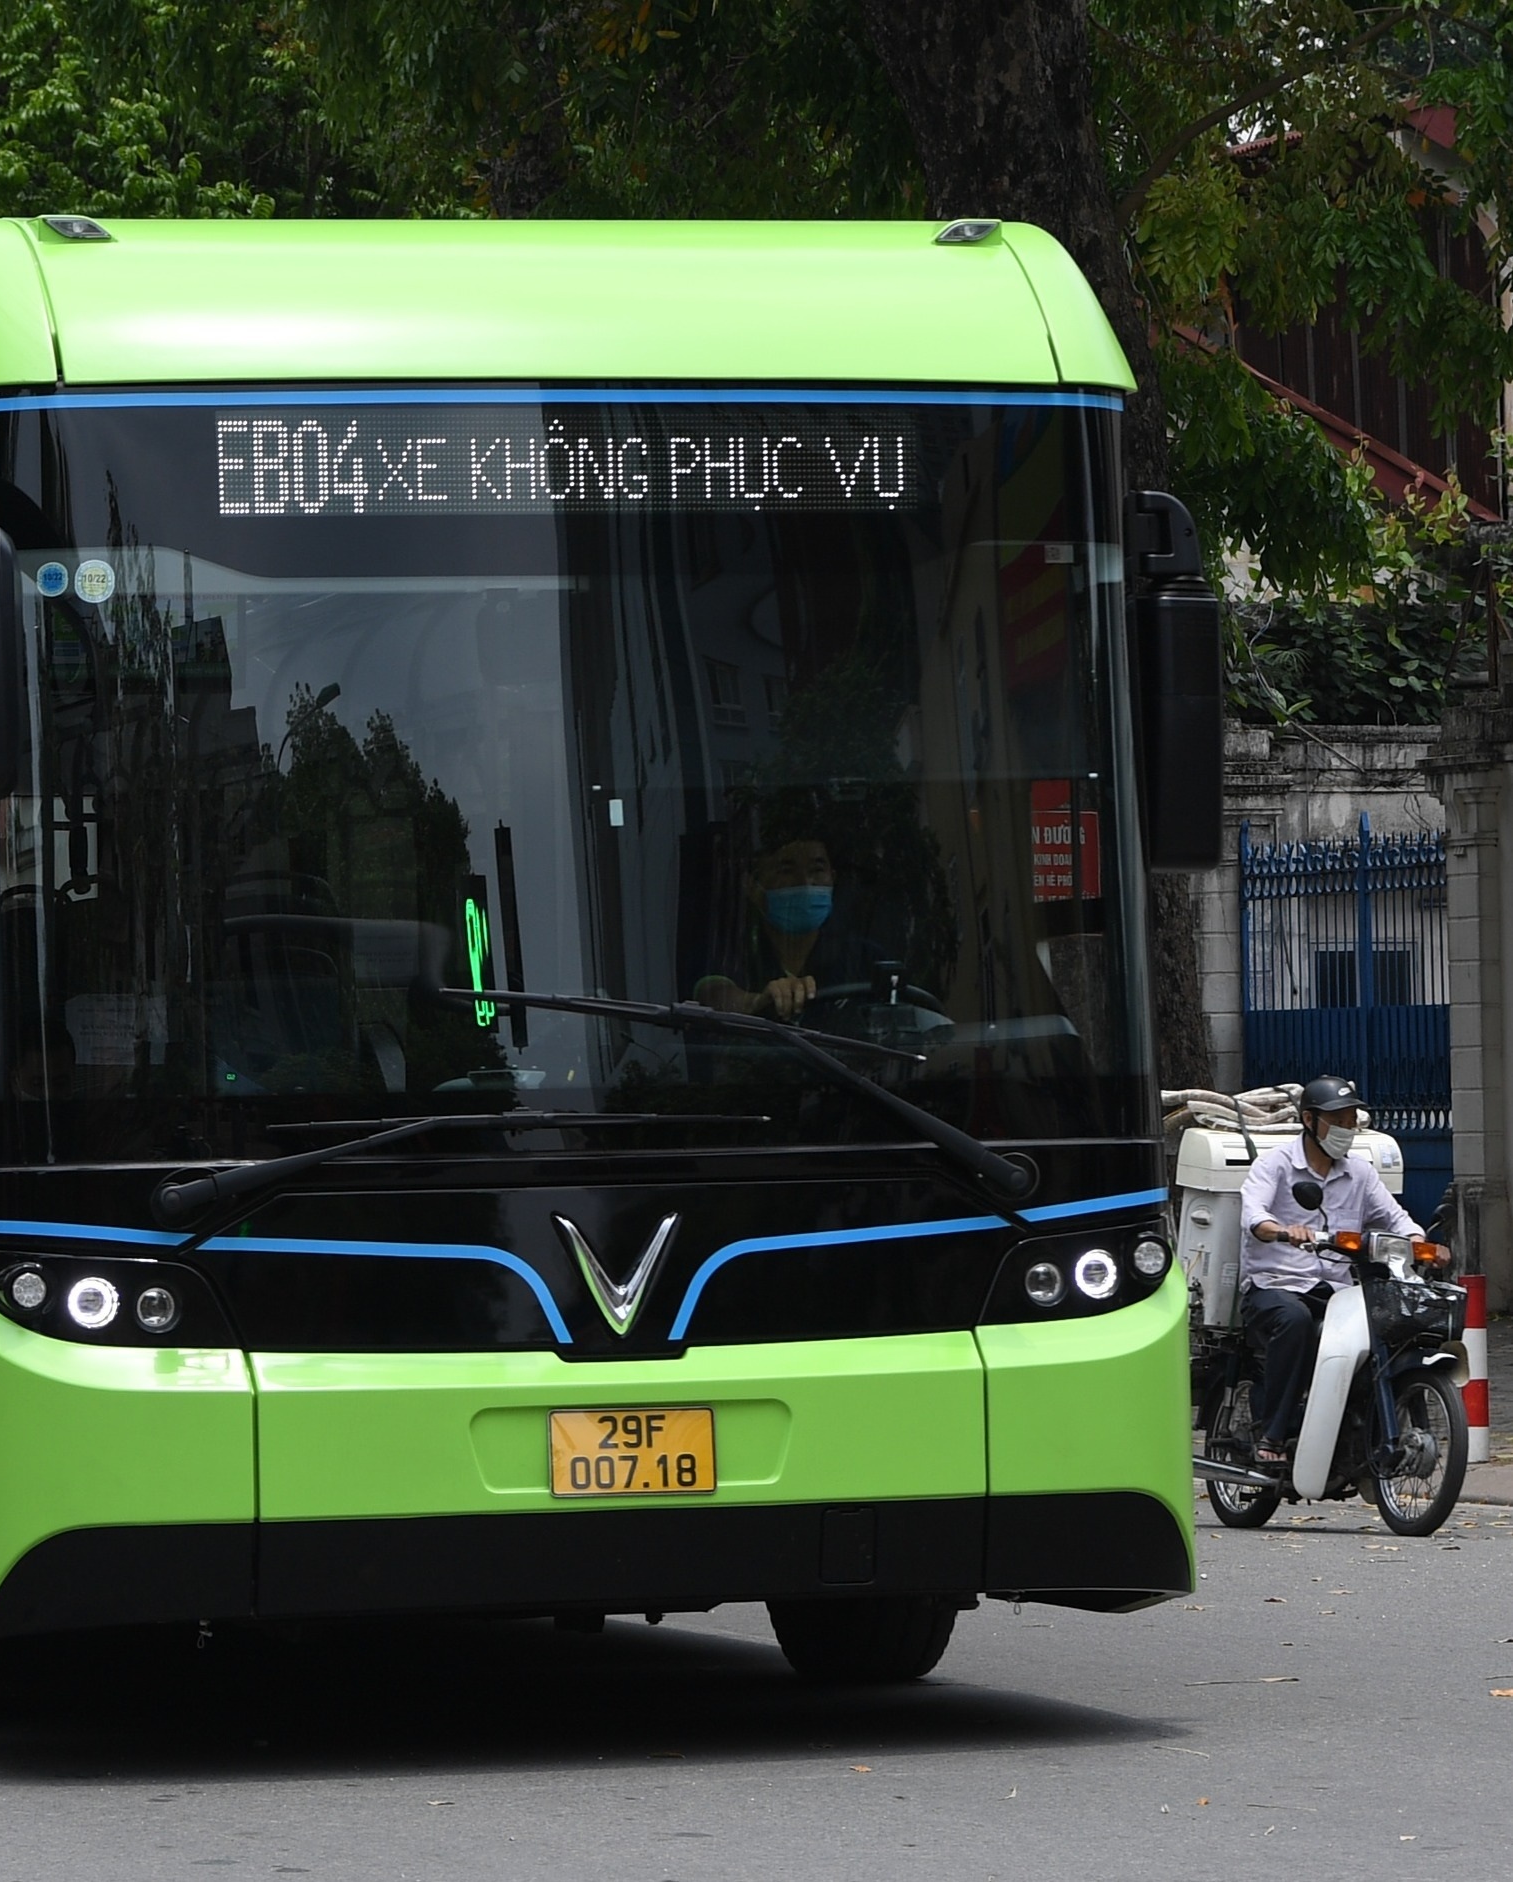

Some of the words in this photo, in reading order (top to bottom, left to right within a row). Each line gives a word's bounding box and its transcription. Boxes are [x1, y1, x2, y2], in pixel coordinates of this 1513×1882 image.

[217, 420, 368, 514] EB04
[376, 437, 448, 501] XE
[470, 418, 649, 501] KHÔNG
[669, 435, 804, 512] PHỤC
[823, 435, 906, 511] VỤ
[81, 574, 107, 584] 10/22
[1043, 819, 1086, 845] ĐƯỜG
[597, 1413, 666, 1449] 29F
[569, 1453, 697, 1490] 007.18
